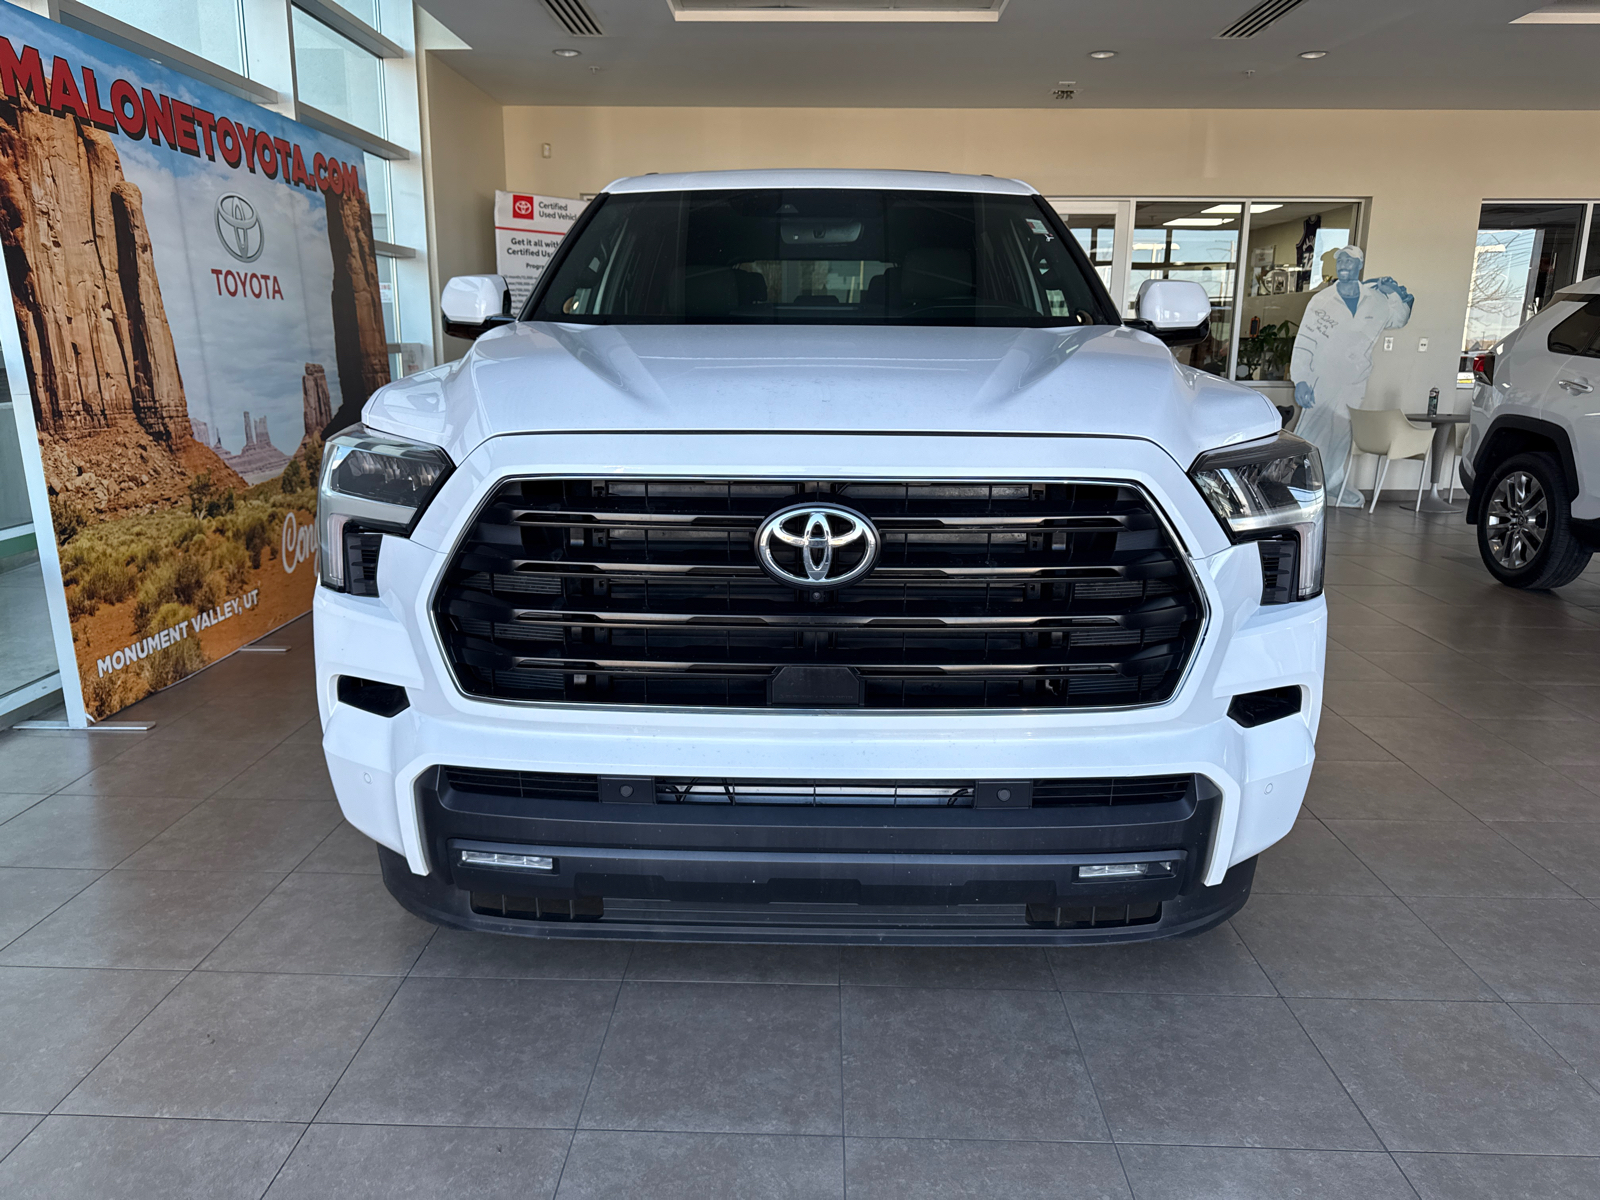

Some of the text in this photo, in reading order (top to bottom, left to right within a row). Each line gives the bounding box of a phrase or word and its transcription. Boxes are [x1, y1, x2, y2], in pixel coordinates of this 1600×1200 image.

[0, 35, 361, 199] MALONETOYOTA.COM
[538, 201, 568, 211] Certified
[538, 210, 578, 221] Used Vehicl
[511, 237, 525, 246] Get
[526, 238, 532, 246] it
[533, 239, 543, 247] all
[506, 247, 540, 257] Certified
[210, 268, 284, 300] TOYOTA
[96, 588, 259, 678] MONUMENT VALLEY, UT
